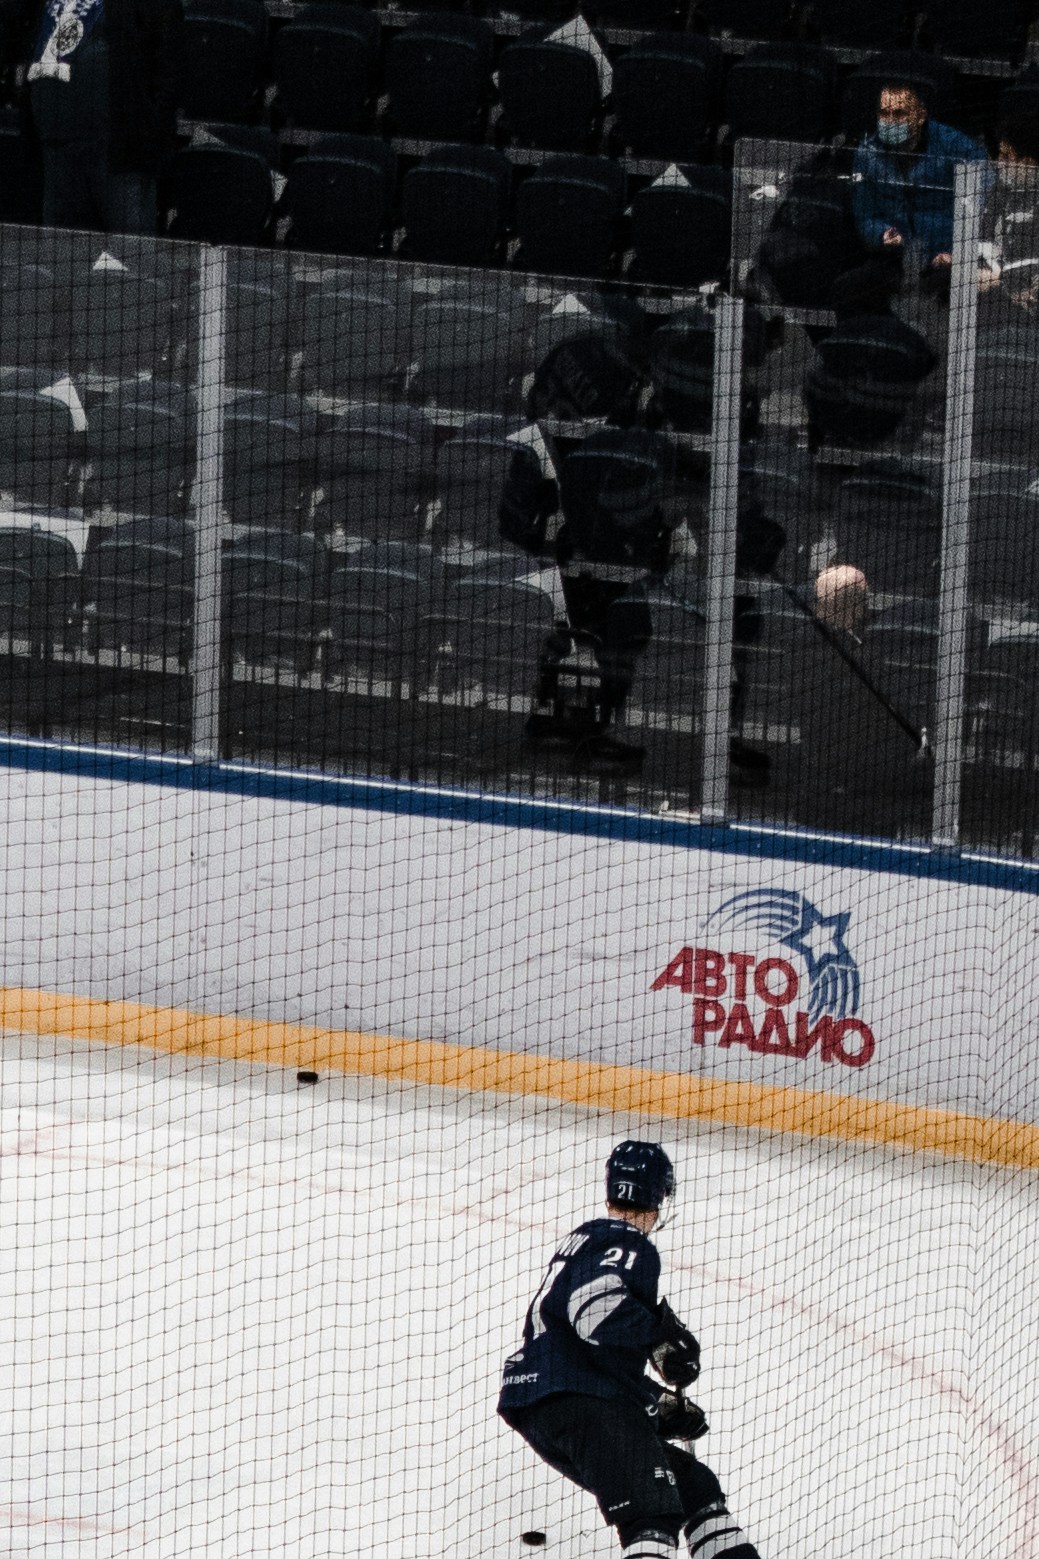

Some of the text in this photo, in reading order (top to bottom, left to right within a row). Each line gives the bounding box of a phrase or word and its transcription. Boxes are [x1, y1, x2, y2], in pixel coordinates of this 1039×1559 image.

[649, 946, 799, 1007] АВТО
[693, 997, 875, 1067] РАДИО
[617, 1184, 634, 1200] 21
[600, 1247, 637, 1270] 21
